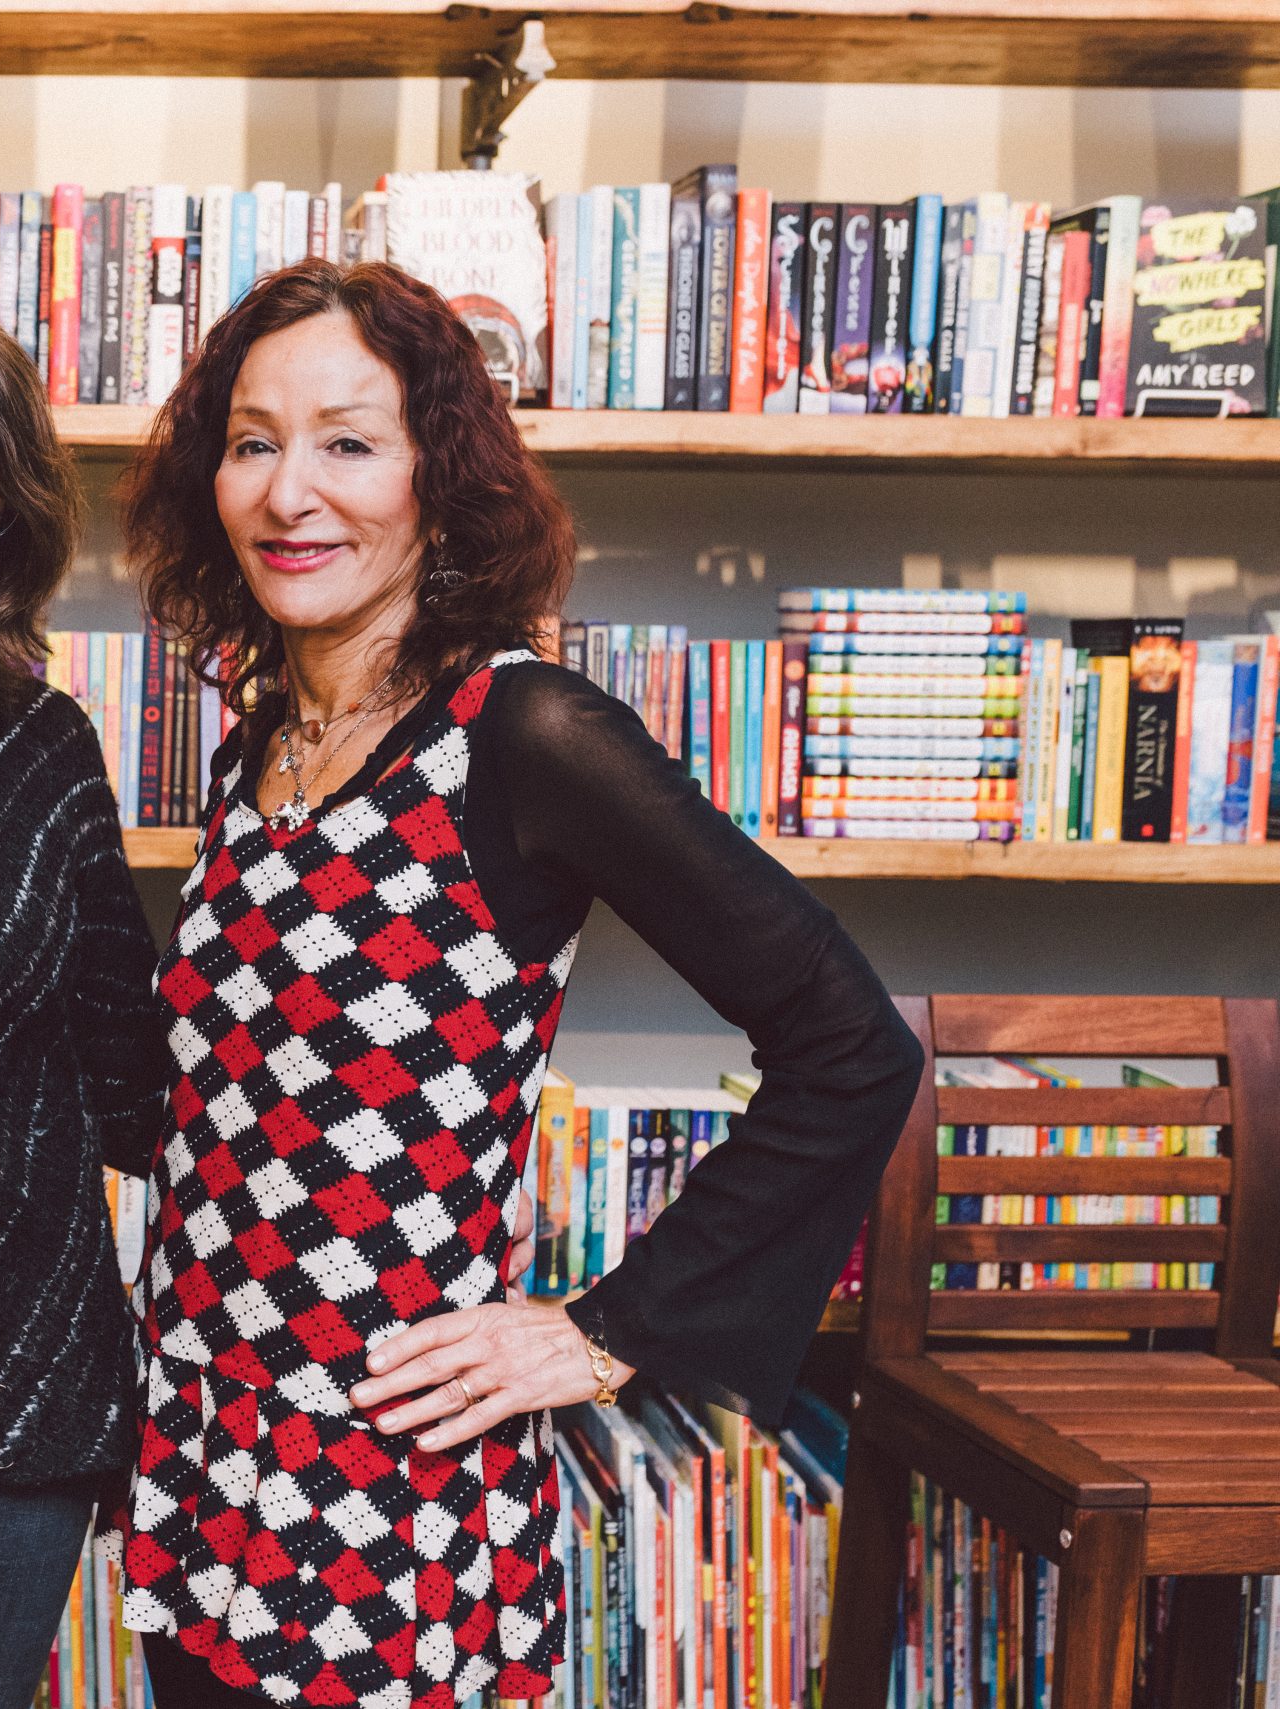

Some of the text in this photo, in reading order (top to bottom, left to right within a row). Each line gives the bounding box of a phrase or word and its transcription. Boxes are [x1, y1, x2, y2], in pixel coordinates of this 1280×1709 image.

[1169, 227, 1207, 245] THE
[844, 214, 870, 332] Cress
[164, 312, 177, 356] LEIA
[1179, 312, 1240, 338] GIRLS
[1135, 363, 1256, 390] AMY REED
[1133, 704, 1157, 801] NARNIA
